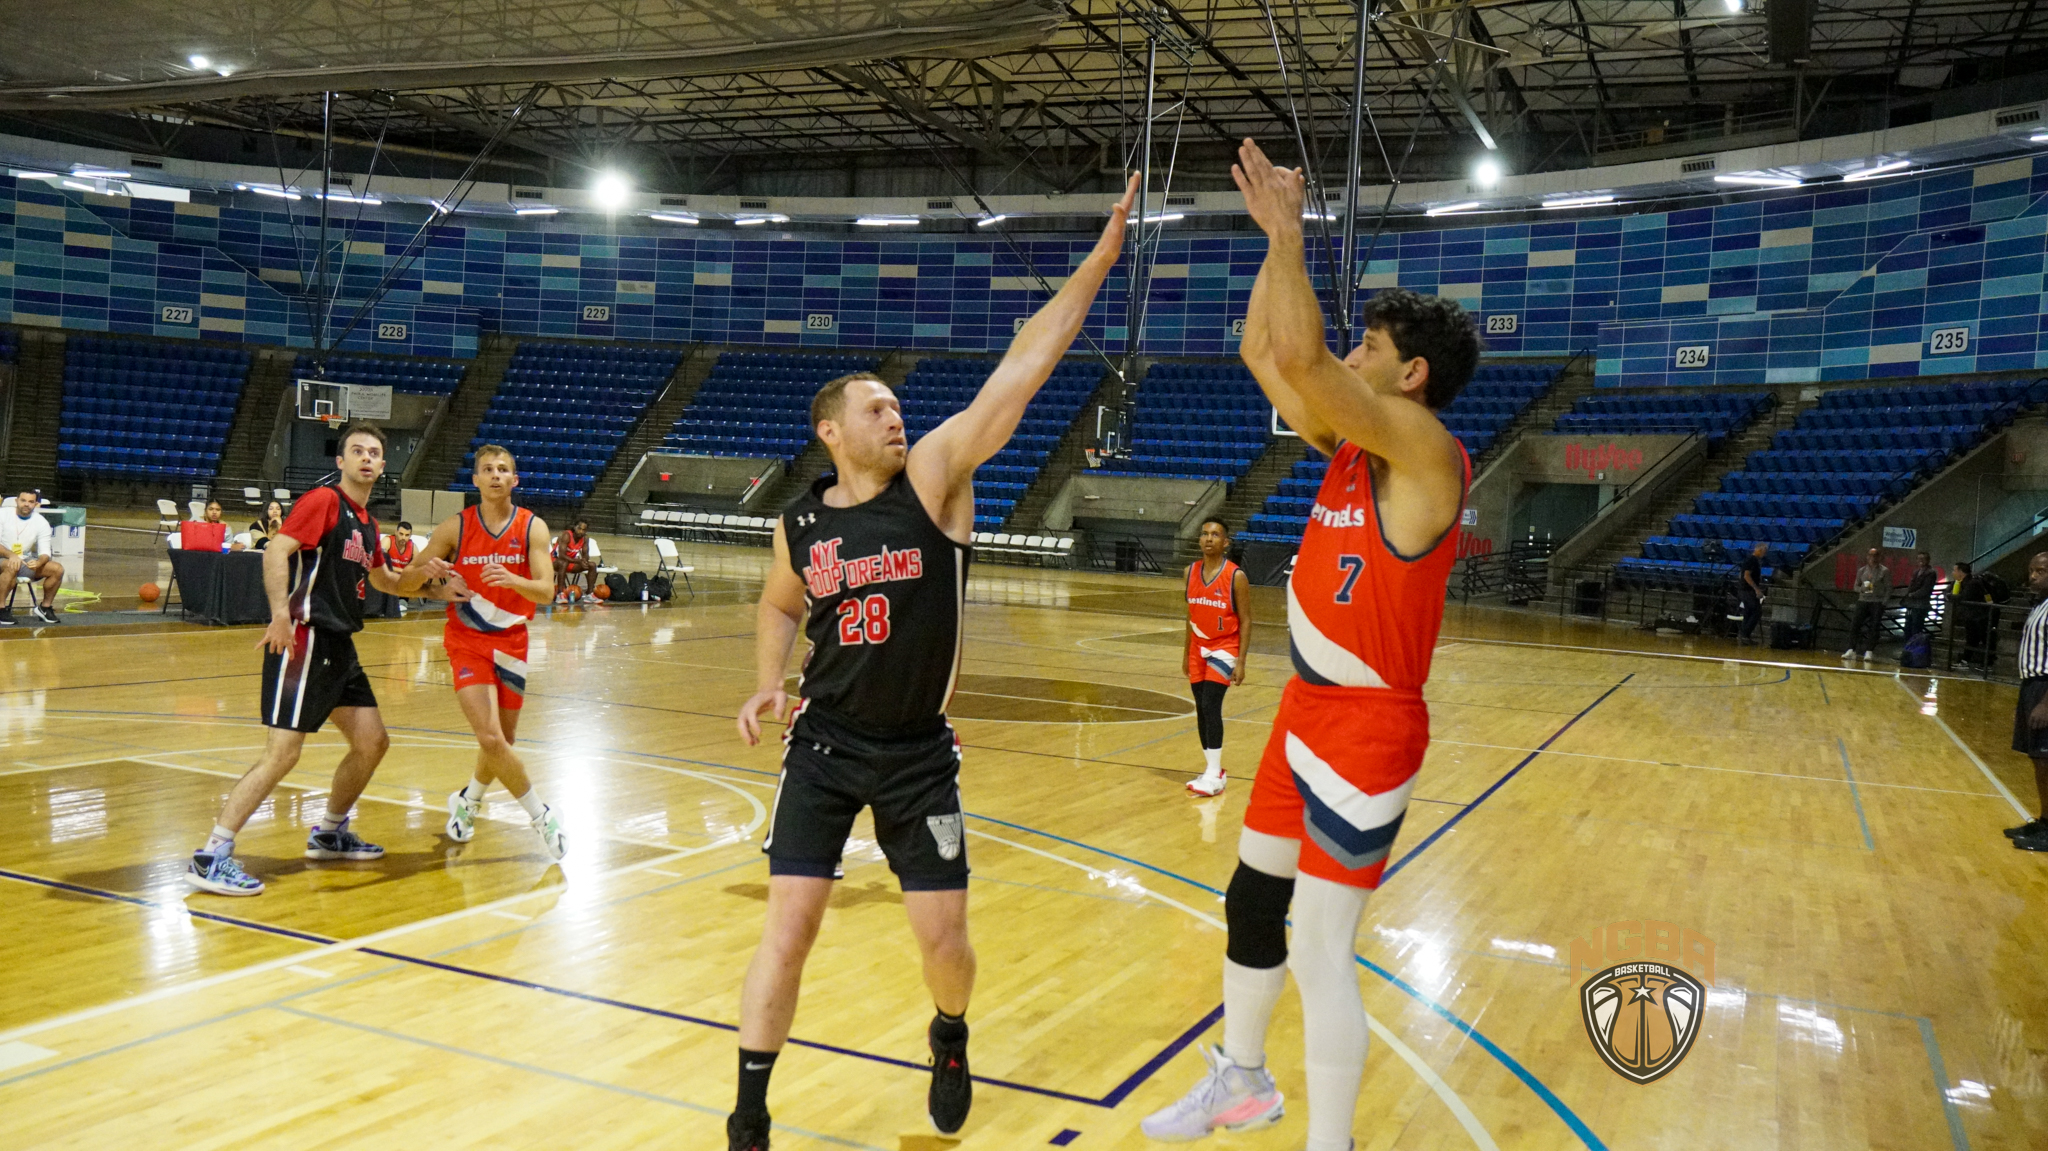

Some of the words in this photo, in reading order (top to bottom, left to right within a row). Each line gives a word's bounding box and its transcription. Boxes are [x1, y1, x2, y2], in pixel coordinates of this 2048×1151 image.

[166, 309, 189, 321] 227
[586, 308, 606, 319] 229
[810, 316, 830, 327] 230
[1490, 318, 1514, 330] 233
[382, 326, 404, 337] 228
[1935, 332, 1964, 350] 235
[1680, 350, 1706, 364] 234
[462, 552, 525, 565] sentinels
[809, 537, 844, 572] NYC
[803, 564, 845, 598] HOOP
[845, 545, 923, 588] DREAMS
[1334, 554, 1366, 604] 7
[836, 593, 890, 646] 28
[1217, 616, 1224, 631] 1
